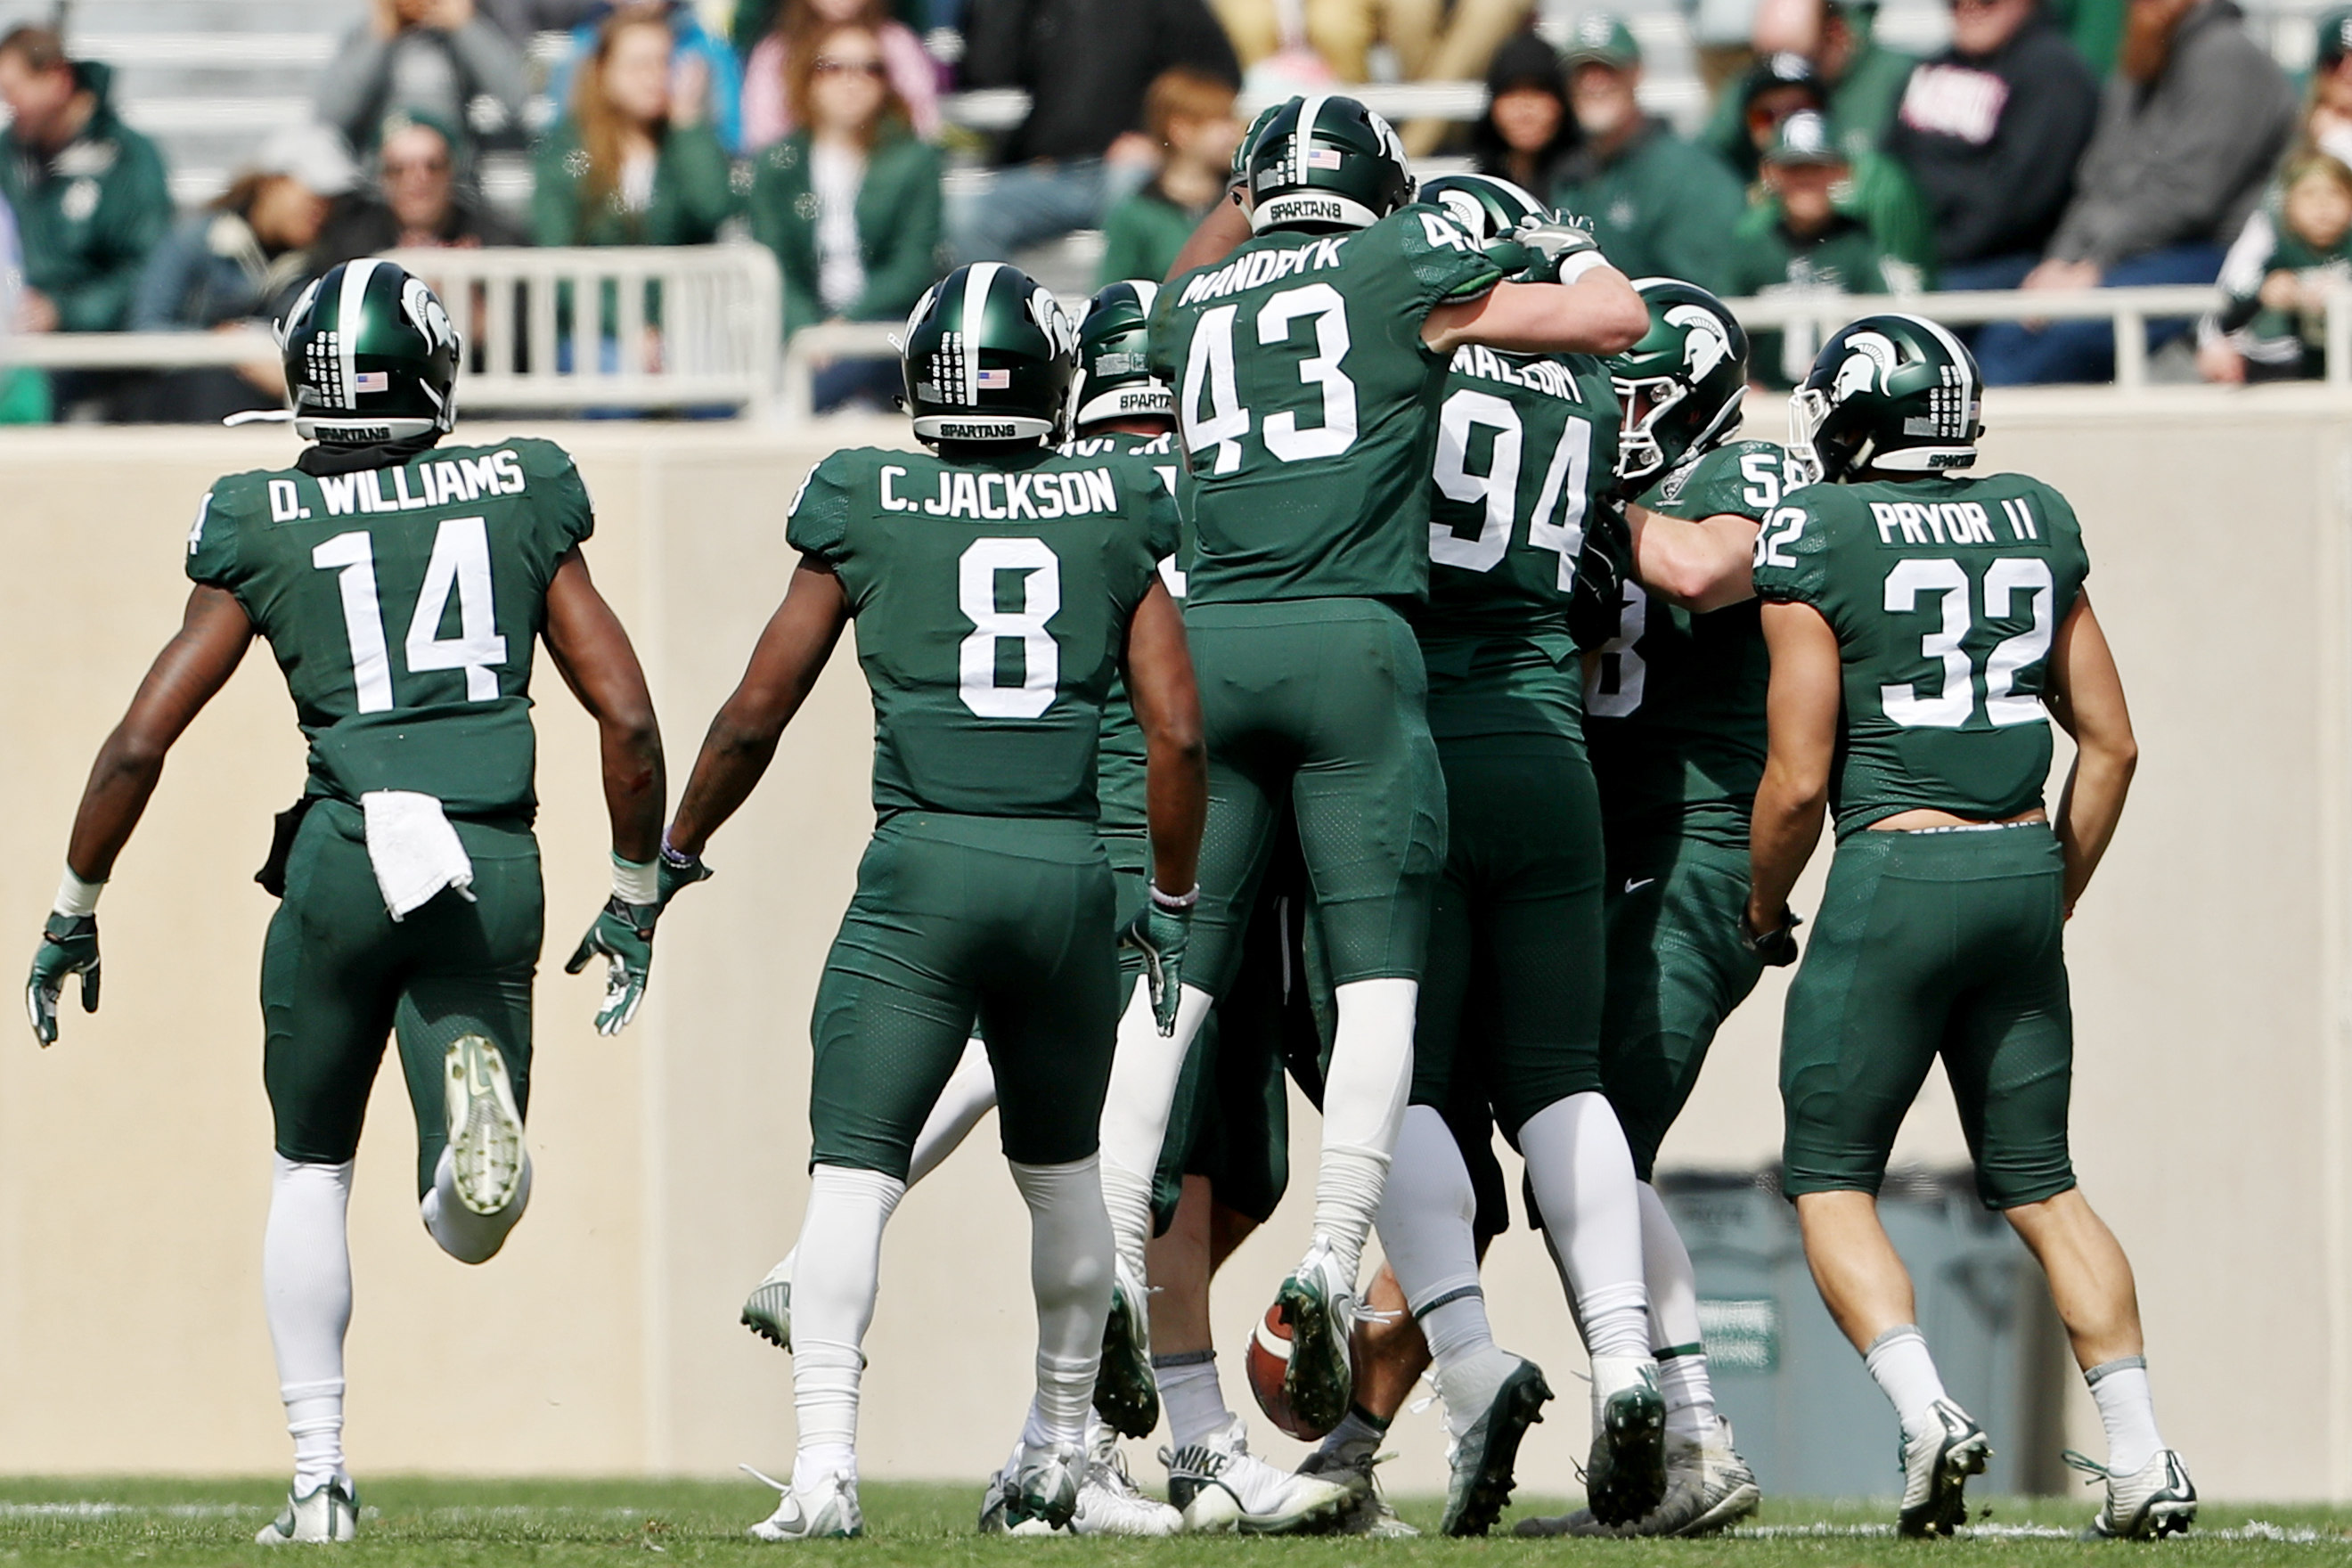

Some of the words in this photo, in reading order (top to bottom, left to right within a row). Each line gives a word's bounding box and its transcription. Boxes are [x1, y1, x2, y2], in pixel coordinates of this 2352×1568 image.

[1270, 200, 1342, 222] SPARTANS
[1177, 237, 1350, 308] MANDRYK
[1180, 282, 1359, 476] 43
[1449, 343, 1583, 404] MALLORY
[314, 426, 391, 442] SPARTANS
[940, 424, 1016, 438] SPARTANS
[268, 479, 311, 523] D.
[318, 449, 527, 516] WILLIAMS
[1429, 388, 1592, 593] 94
[1869, 502, 1996, 544] PRYOR
[312, 517, 508, 714] 14
[960, 537, 1060, 718] 8
[1881, 558, 2054, 727] 32
[1172, 1443, 1228, 1479] NIKE
